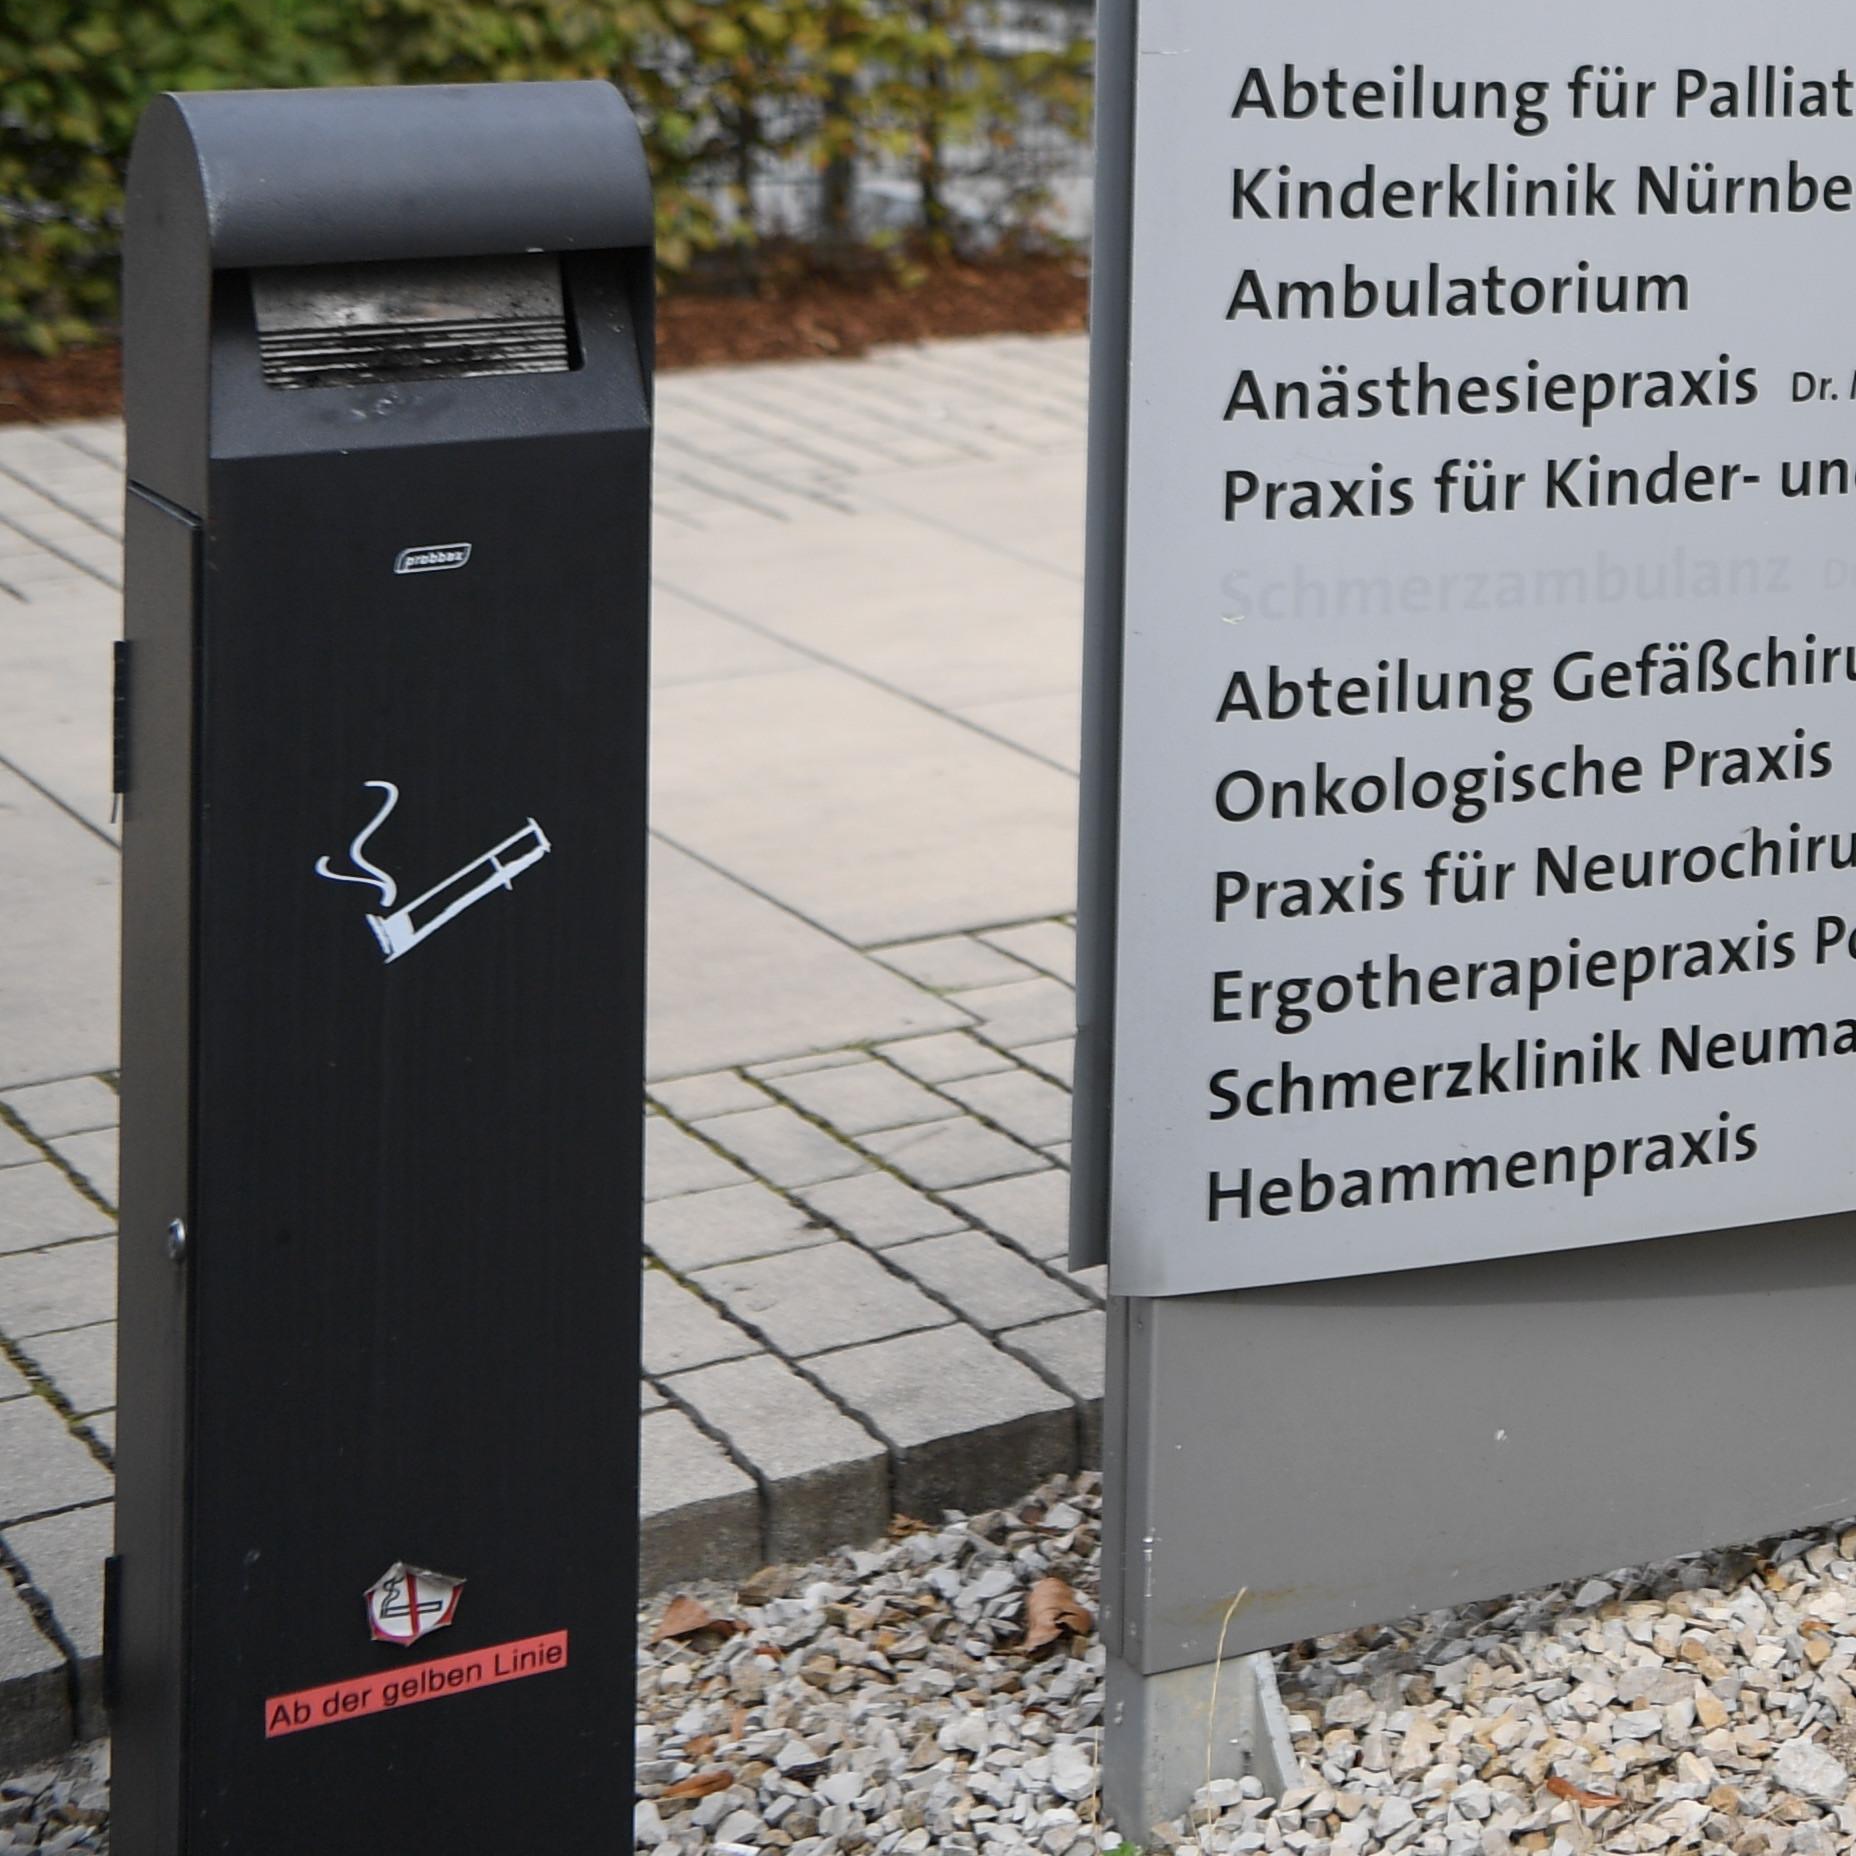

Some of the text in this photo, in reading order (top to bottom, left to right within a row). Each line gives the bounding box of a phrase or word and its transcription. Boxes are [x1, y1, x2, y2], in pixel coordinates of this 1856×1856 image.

[1229, 62, 1551, 138] Abteilung
[1566, 63, 1658, 120] für
[1231, 160, 1618, 221] Kinderklinik
[1223, 258, 1690, 322] Ambulatorium
[1221, 351, 1759, 429] Anästhesiepraxis
[1790, 370, 1840, 404] Dr.
[1223, 460, 1415, 523] Praxis
[1432, 457, 1527, 515] für
[1544, 448, 1762, 510] Kinder-
[1219, 547, 1792, 624] Schmerzambulanz
[1214, 656, 1535, 725] Abteilung
[1214, 742, 1644, 825] Onkologische
[1662, 726, 1834, 791] Praxis
[1214, 857, 1406, 924] Praxis
[1423, 848, 1517, 907] für
[1211, 917, 1797, 1036] Ergotherapiepraxis
[1207, 1027, 1642, 1122] Schmerzklinik
[1206, 1109, 1759, 1223] Hebammenpraxis
[269, 1642, 563, 1731] Ab der gelben Linie
